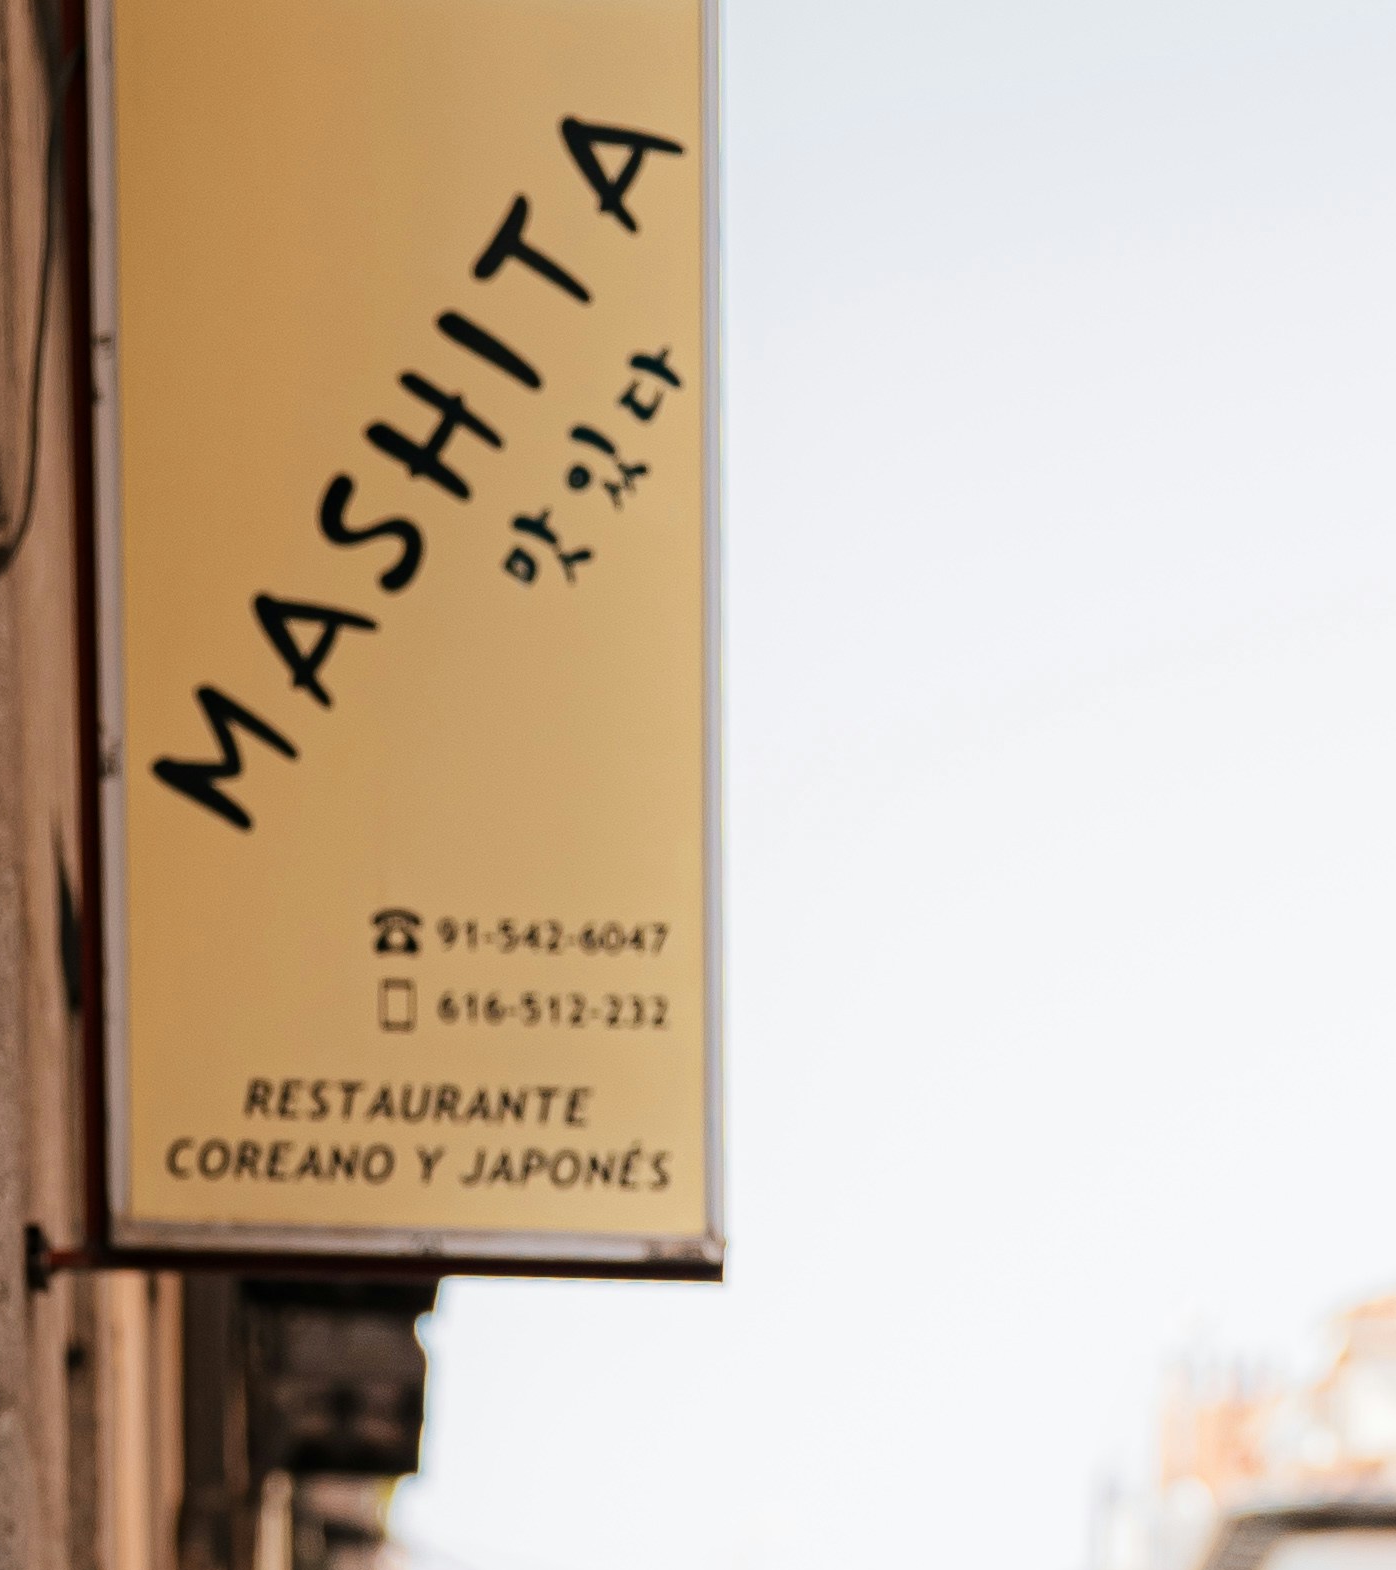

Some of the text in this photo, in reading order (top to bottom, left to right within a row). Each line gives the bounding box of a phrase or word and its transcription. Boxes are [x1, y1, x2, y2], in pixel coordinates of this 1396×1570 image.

[150, 115, 686, 833] MASHITA
[503, 345, 685, 583] 맛있다
[437, 917, 670, 956] 91-542-6047
[437, 990, 670, 1029] 616-512-232
[243, 1077, 593, 1129] RESTAURANTE
[165, 1137, 672, 1192] COREANO Y JAPONÉS
